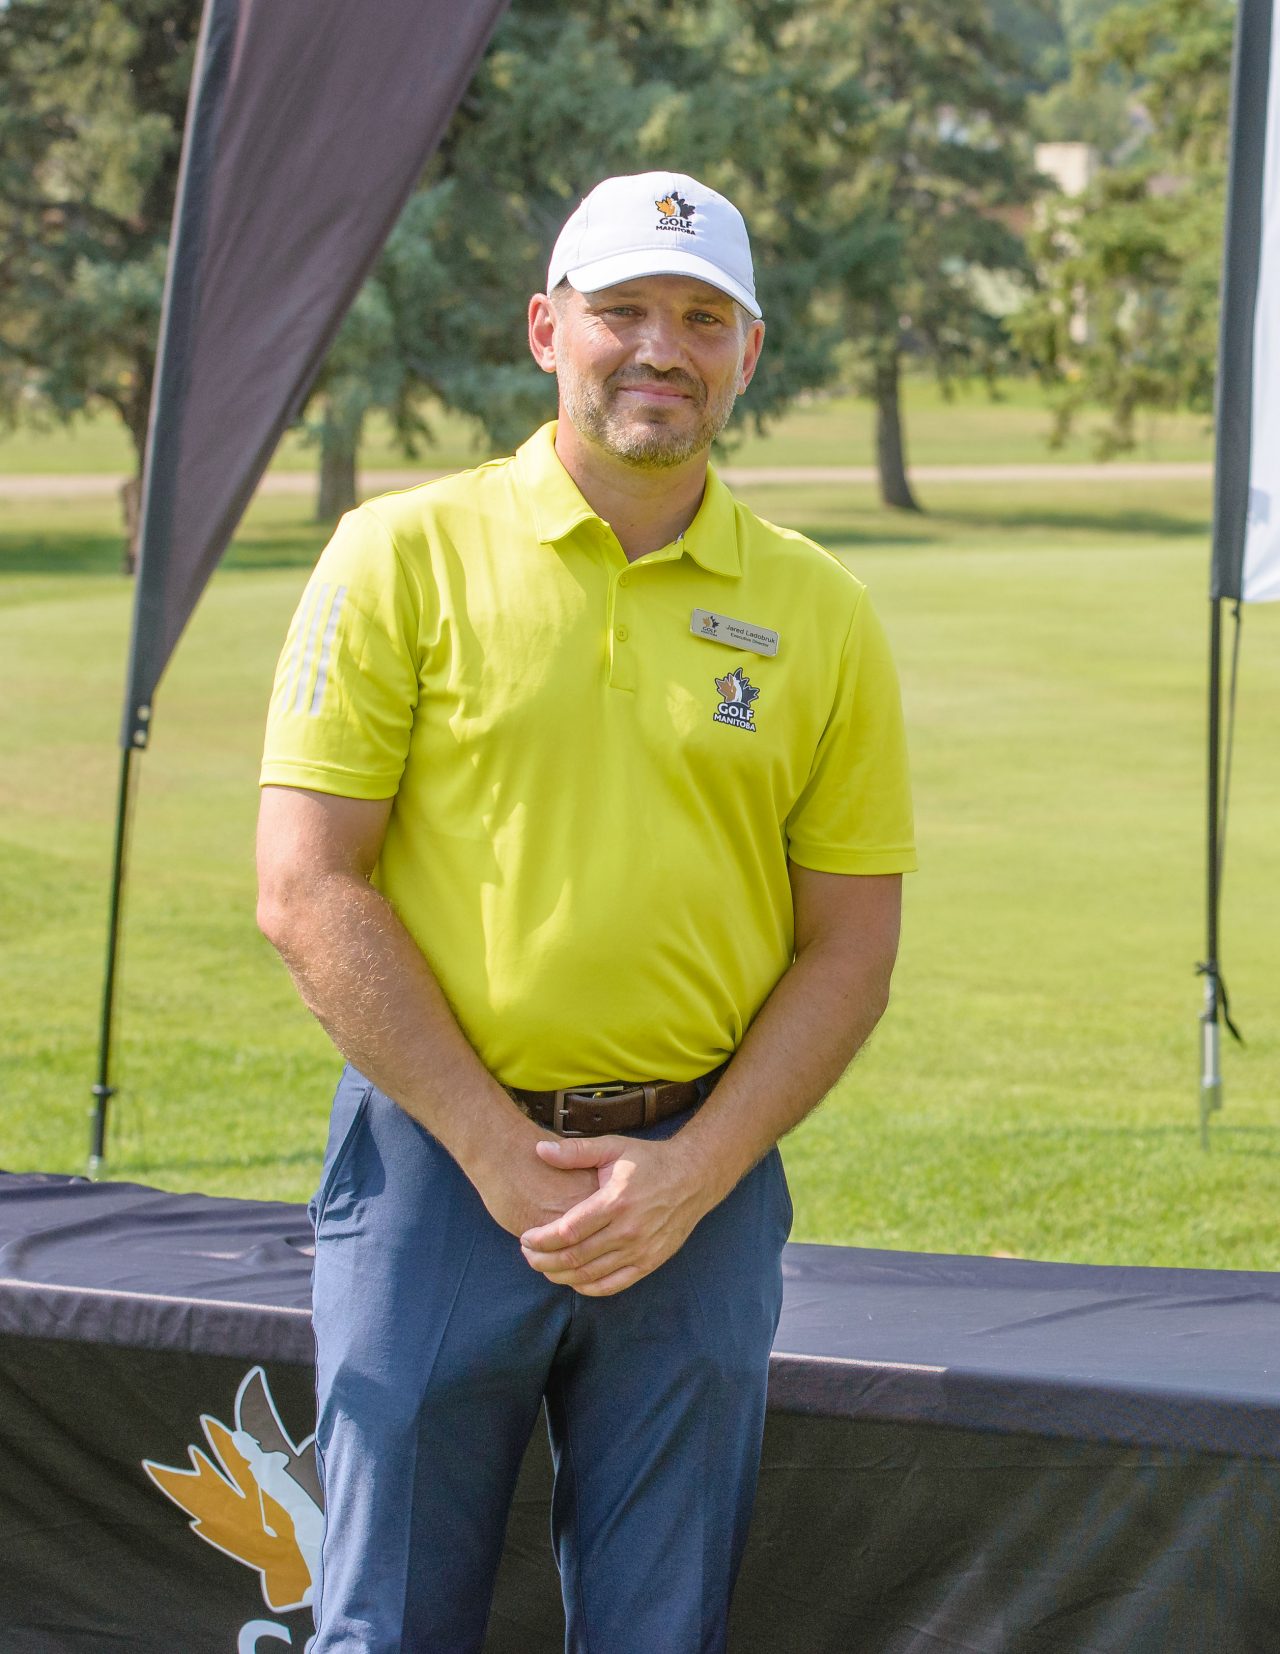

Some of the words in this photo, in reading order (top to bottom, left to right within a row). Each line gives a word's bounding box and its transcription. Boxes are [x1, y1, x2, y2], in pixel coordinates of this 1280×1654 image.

[656, 225, 696, 235] MANITOBA
[659, 217, 693, 228] GOLF
[726, 625, 745, 635] Jared
[746, 630, 775, 644] Ladobruk
[718, 703, 754, 720] GOLF
[714, 714, 756, 732] MANITOBA
